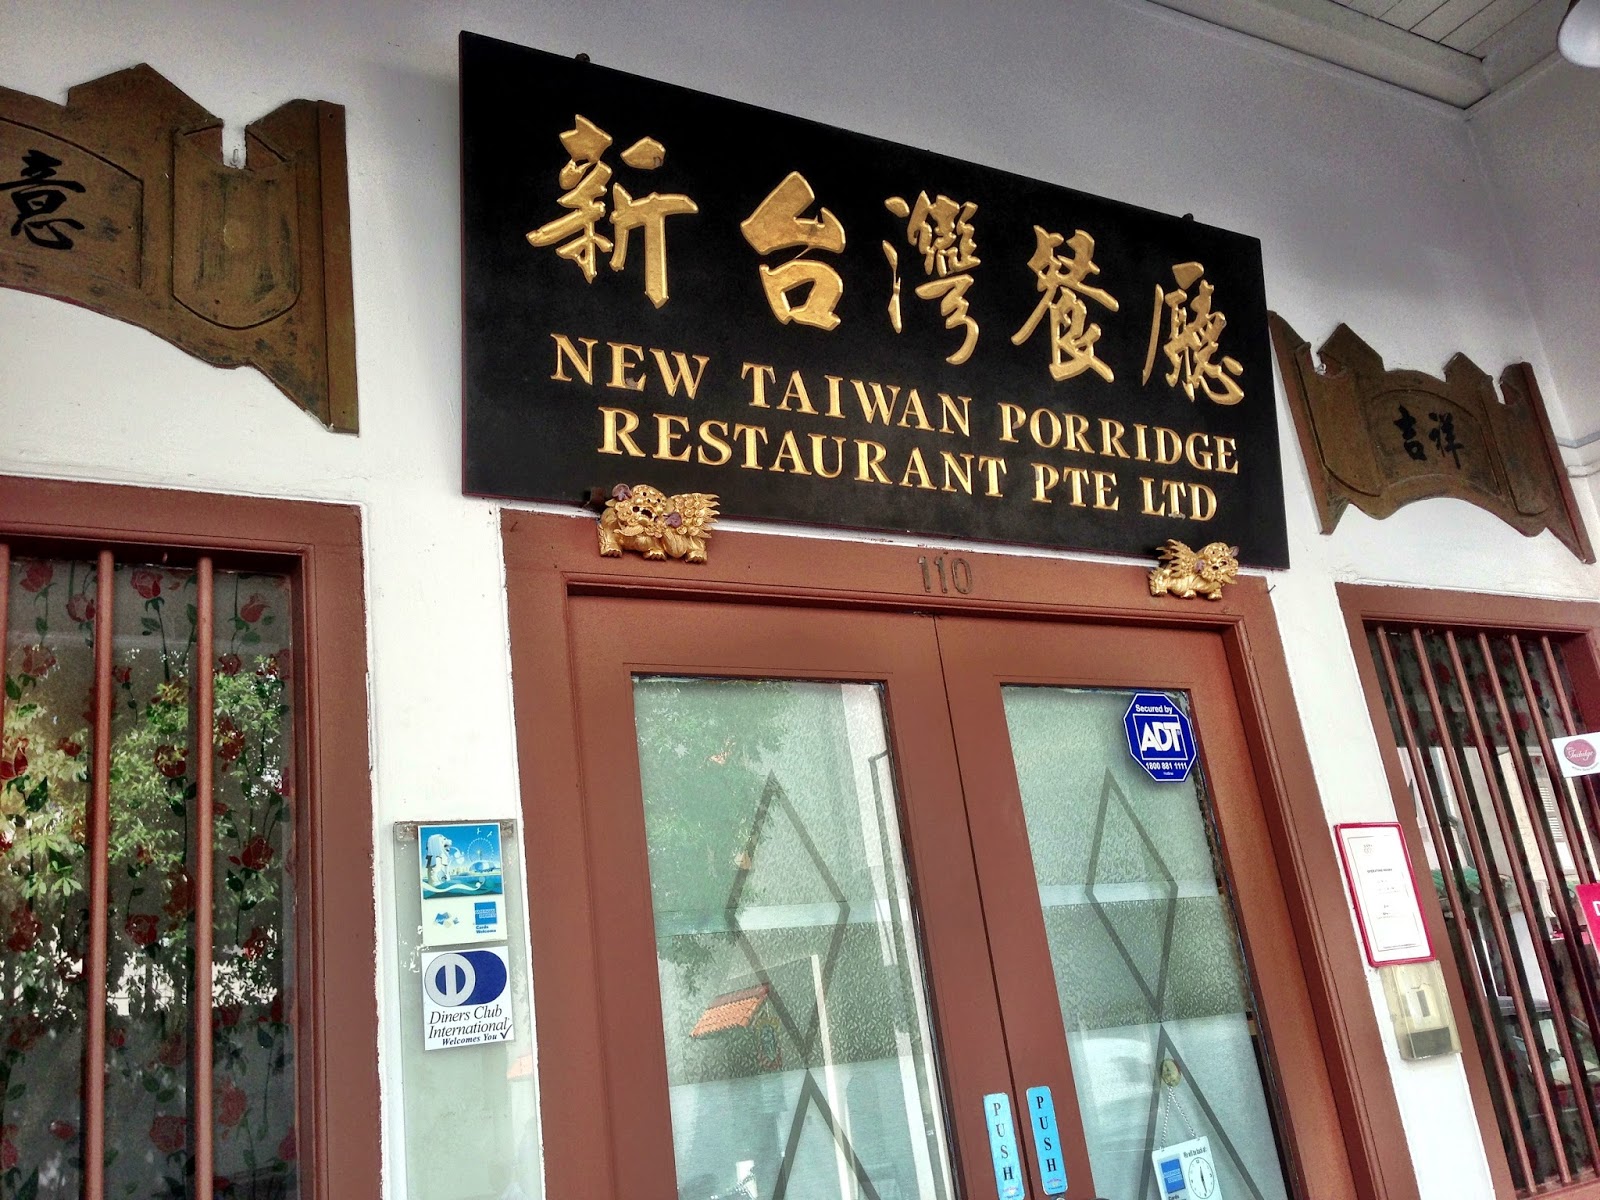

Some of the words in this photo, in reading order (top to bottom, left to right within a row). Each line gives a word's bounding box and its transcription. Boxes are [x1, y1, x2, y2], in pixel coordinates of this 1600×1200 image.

[0, 150, 86, 250] 意
[551, 333, 710, 400] NEW
[740, 362, 973, 437] TAIWAN
[998, 403, 1239, 475] PORRIDGE
[1393, 404, 1464, 469] 吉祥
[598, 407, 1007, 498] RESTAURANT
[1030, 463, 1120, 511] PTE
[1140, 476, 1218, 522] LTD
[918, 556, 973, 594] 110
[1135, 704, 1163, 713] Secured
[1164, 705, 1173, 715] by
[1141, 722, 1182, 752] ADT
[1145, 762, 1160, 770] 1800
[428, 1011, 471, 1025] Diners
[474, 1004, 502, 1019] Club
[428, 1016, 508, 1039] International
[442, 1036, 481, 1046] Welcomes
[483, 1033, 497, 1041] You
[992, 1102, 1014, 1181] PUSH
[1036, 1095, 1057, 1172] PUSH
